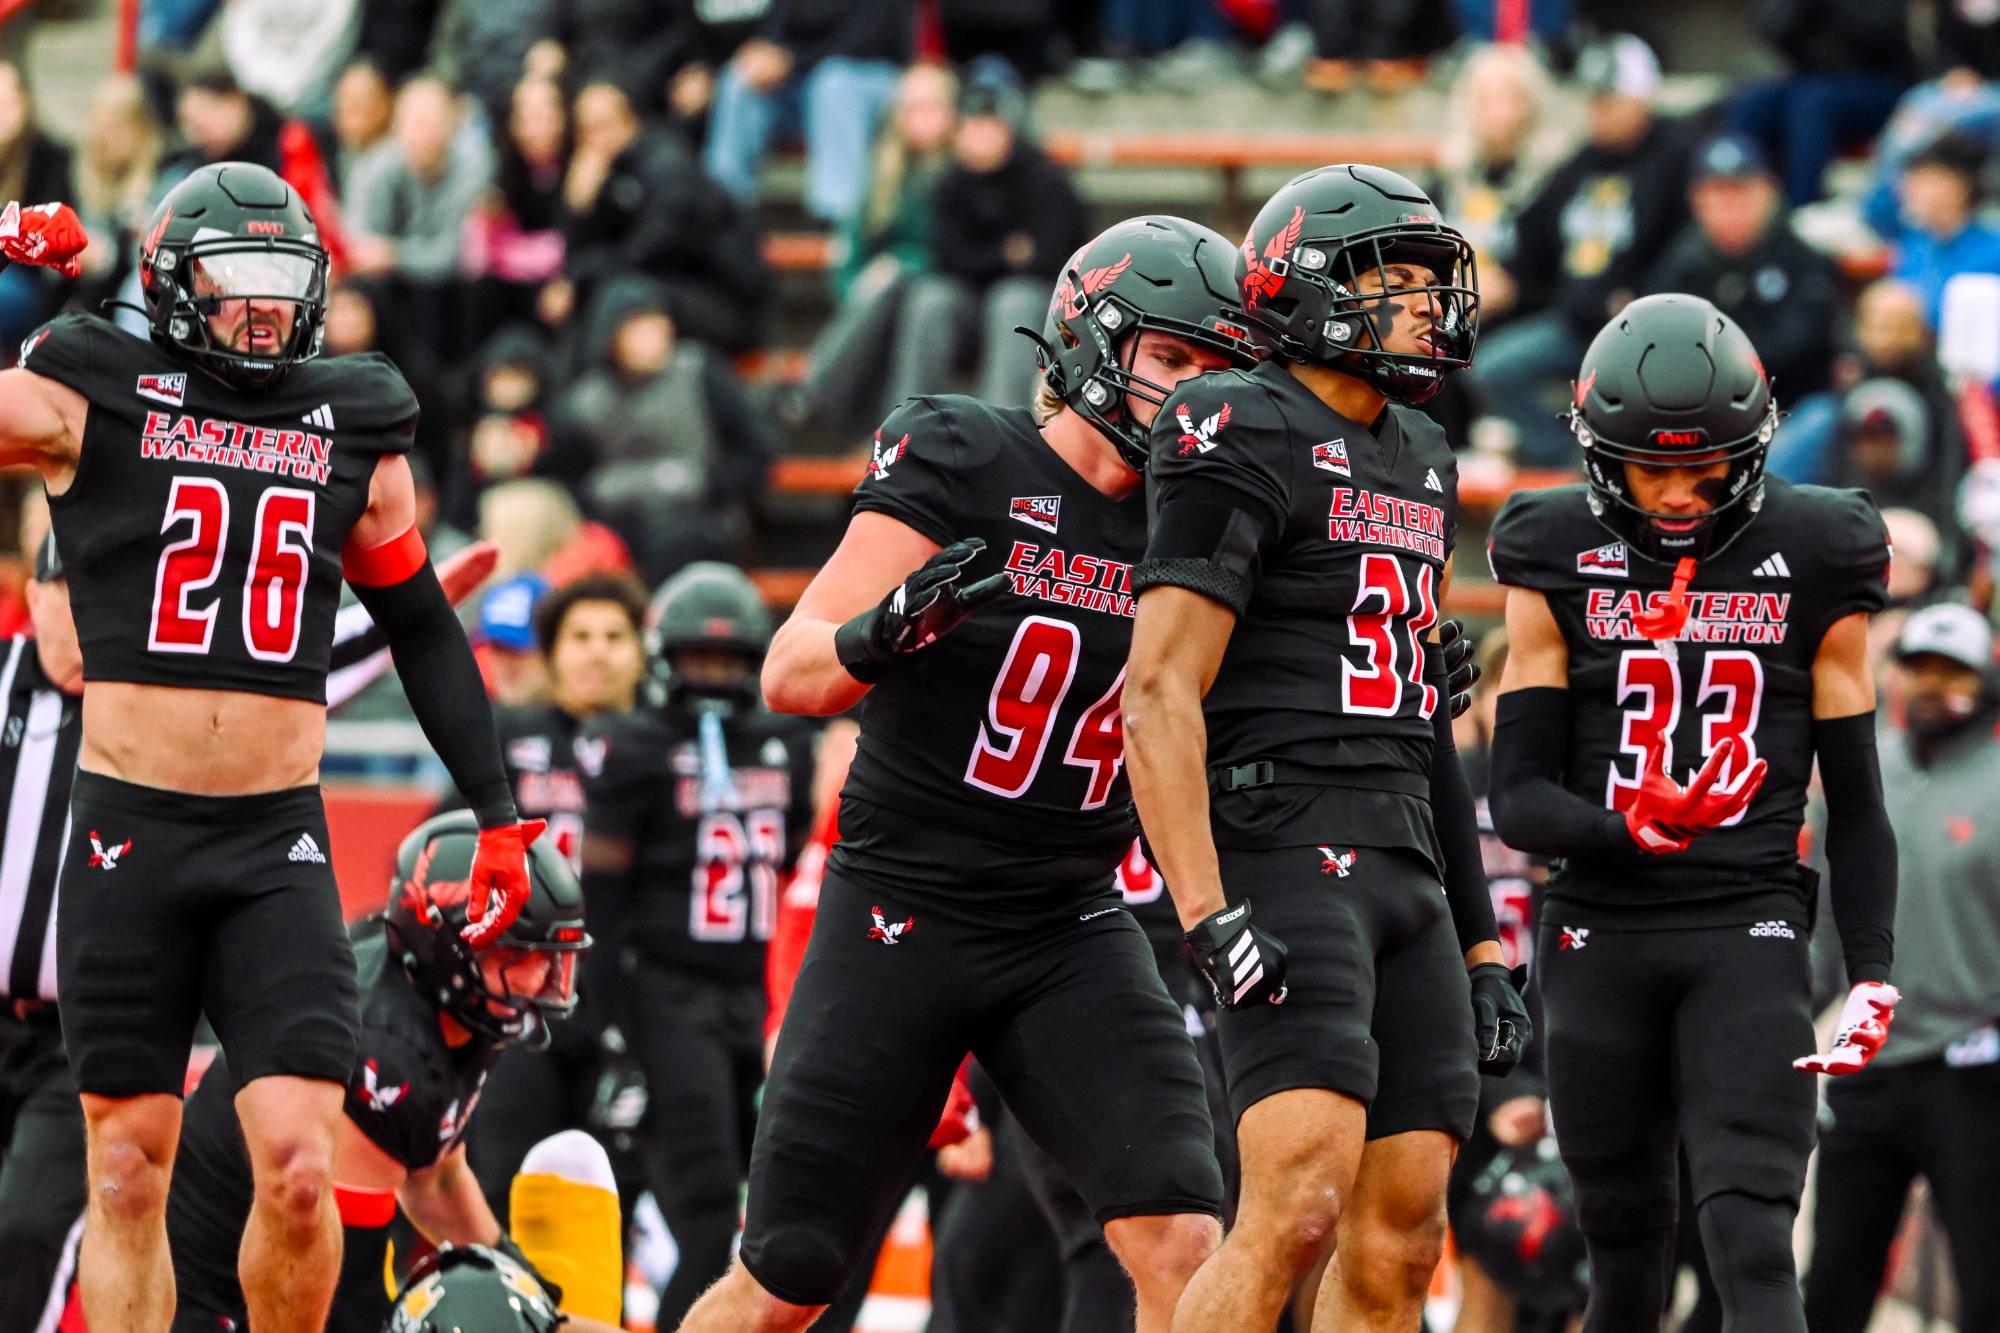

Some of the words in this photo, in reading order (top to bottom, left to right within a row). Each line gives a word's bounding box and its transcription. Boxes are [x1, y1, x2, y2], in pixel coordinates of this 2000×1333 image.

[247, 220, 284, 236] EWU
[1409, 365, 1437, 378] Riddell
[141, 437, 333, 485] WASHINGTON
[143, 410, 333, 464] EASTERN
[1657, 432, 1699, 446] EWU
[1329, 487, 1445, 539] EASTERN
[147, 475, 316, 663] 26
[963, 614, 1128, 811] 94
[1606, 649, 1764, 826] 33
[288, 850, 327, 864] adidas
[1749, 924, 1796, 940] adidas
